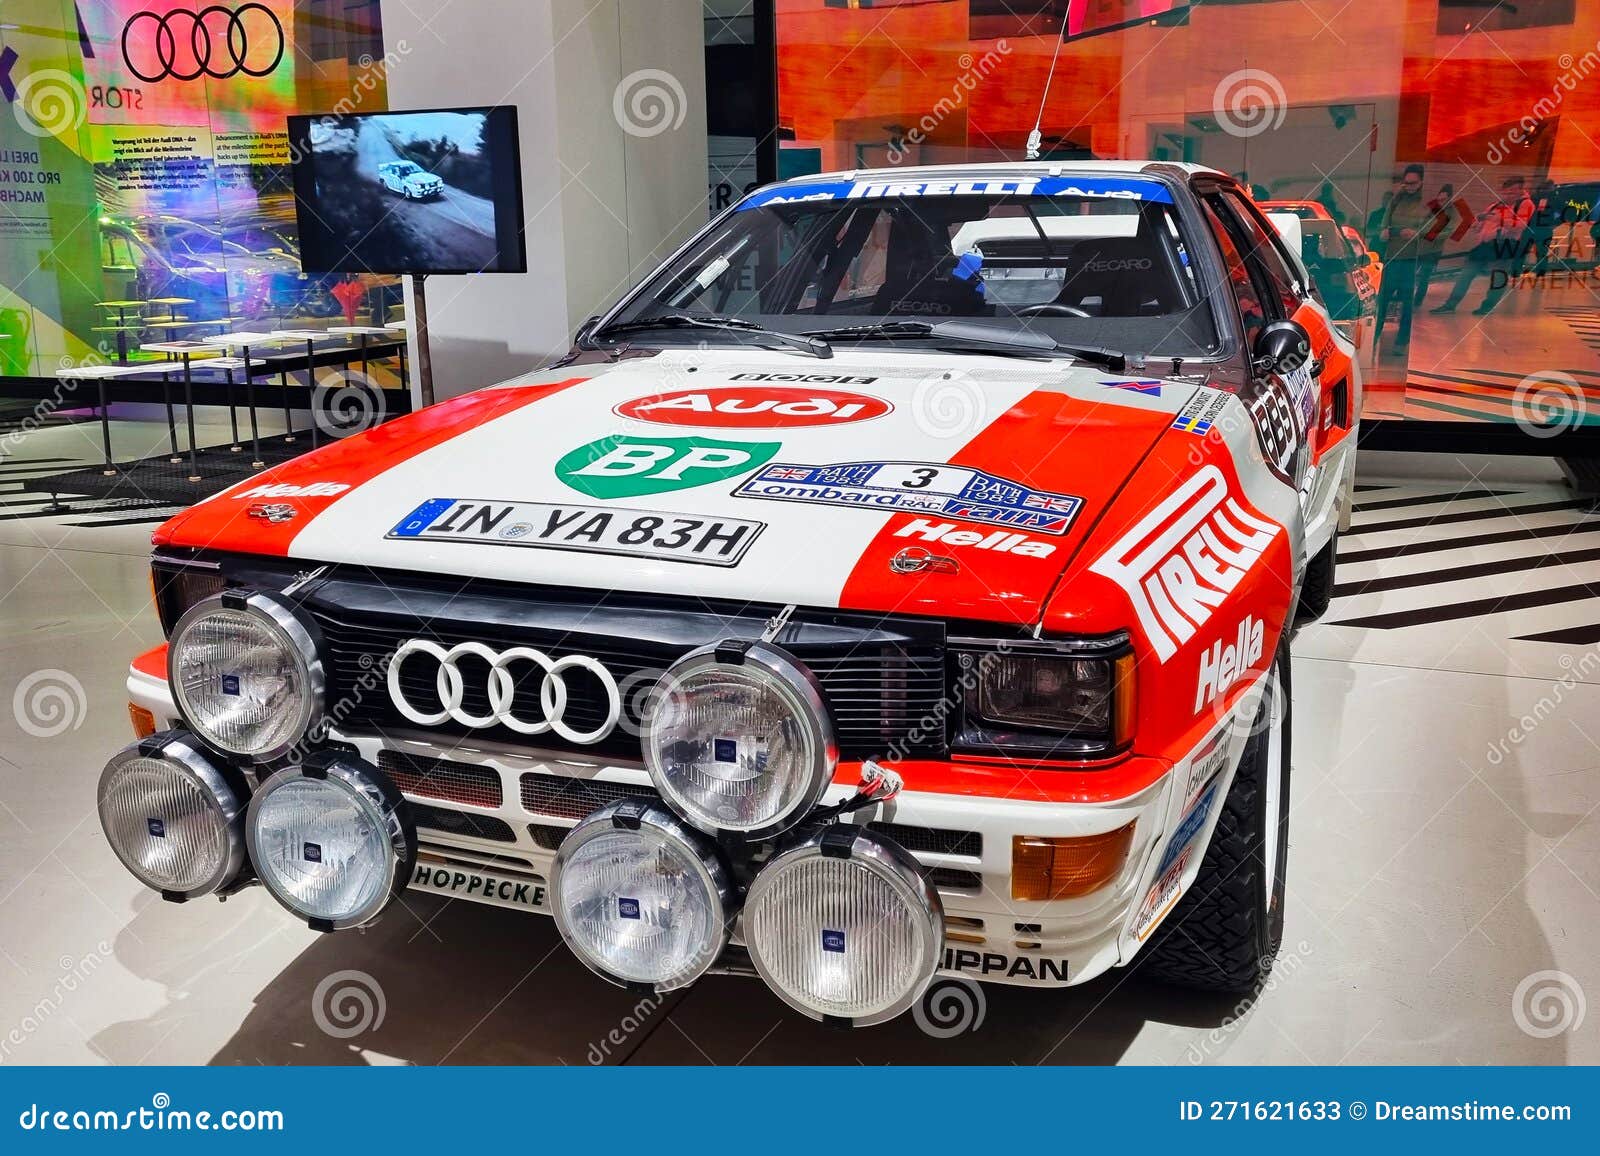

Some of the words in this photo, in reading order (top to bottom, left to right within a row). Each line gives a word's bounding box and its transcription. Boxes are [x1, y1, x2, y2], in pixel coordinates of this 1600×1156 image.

[847, 176, 1041, 198] PIRELLI
[1085, 258, 1152, 272] RECARO
[890, 300, 951, 314] RECARO
[568, 442, 751, 481] BP
[231, 482, 352, 500] Hella
[901, 468, 939, 488] 3
[967, 475, 1023, 498] BATH
[742, 481, 902, 505] Lombard
[901, 500, 941, 510] RAC
[964, 490, 1019, 504] 1983
[405, 519, 423, 531] D
[428, 504, 514, 534] IN
[892, 518, 1057, 559] Hella
[1088, 464, 1282, 665] PIRELLI
[1194, 614, 1264, 717] Hella
[413, 865, 545, 906] HOPPECKE
[938, 948, 1069, 981] IPPAN
